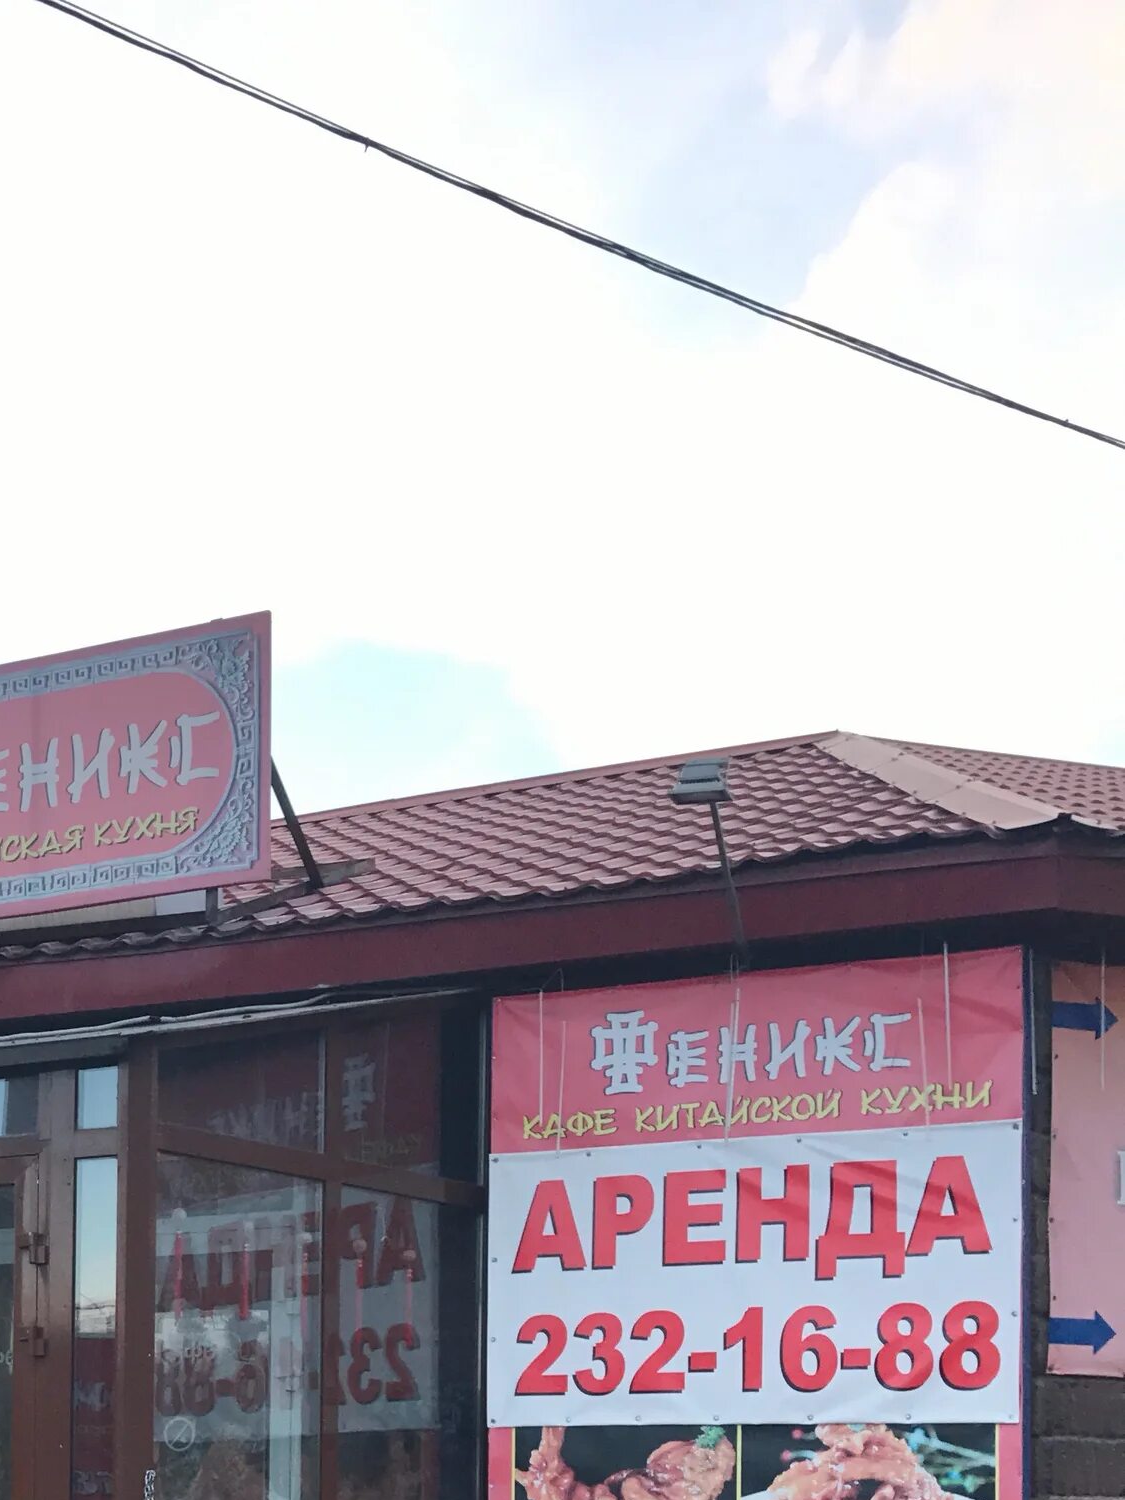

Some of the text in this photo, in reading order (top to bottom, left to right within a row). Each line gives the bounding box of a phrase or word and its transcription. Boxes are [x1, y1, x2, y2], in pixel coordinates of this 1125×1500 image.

[94, 806, 200, 847] КУХНЯ
[590, 1009, 912, 1095] ФЕНИКС
[523, 1108, 618, 1140] КАФЕ
[860, 1080, 993, 1117] КУХНИ
[511, 1155, 994, 1281] АРЕНДА
[514, 1300, 1001, 1397] 232-16-88
